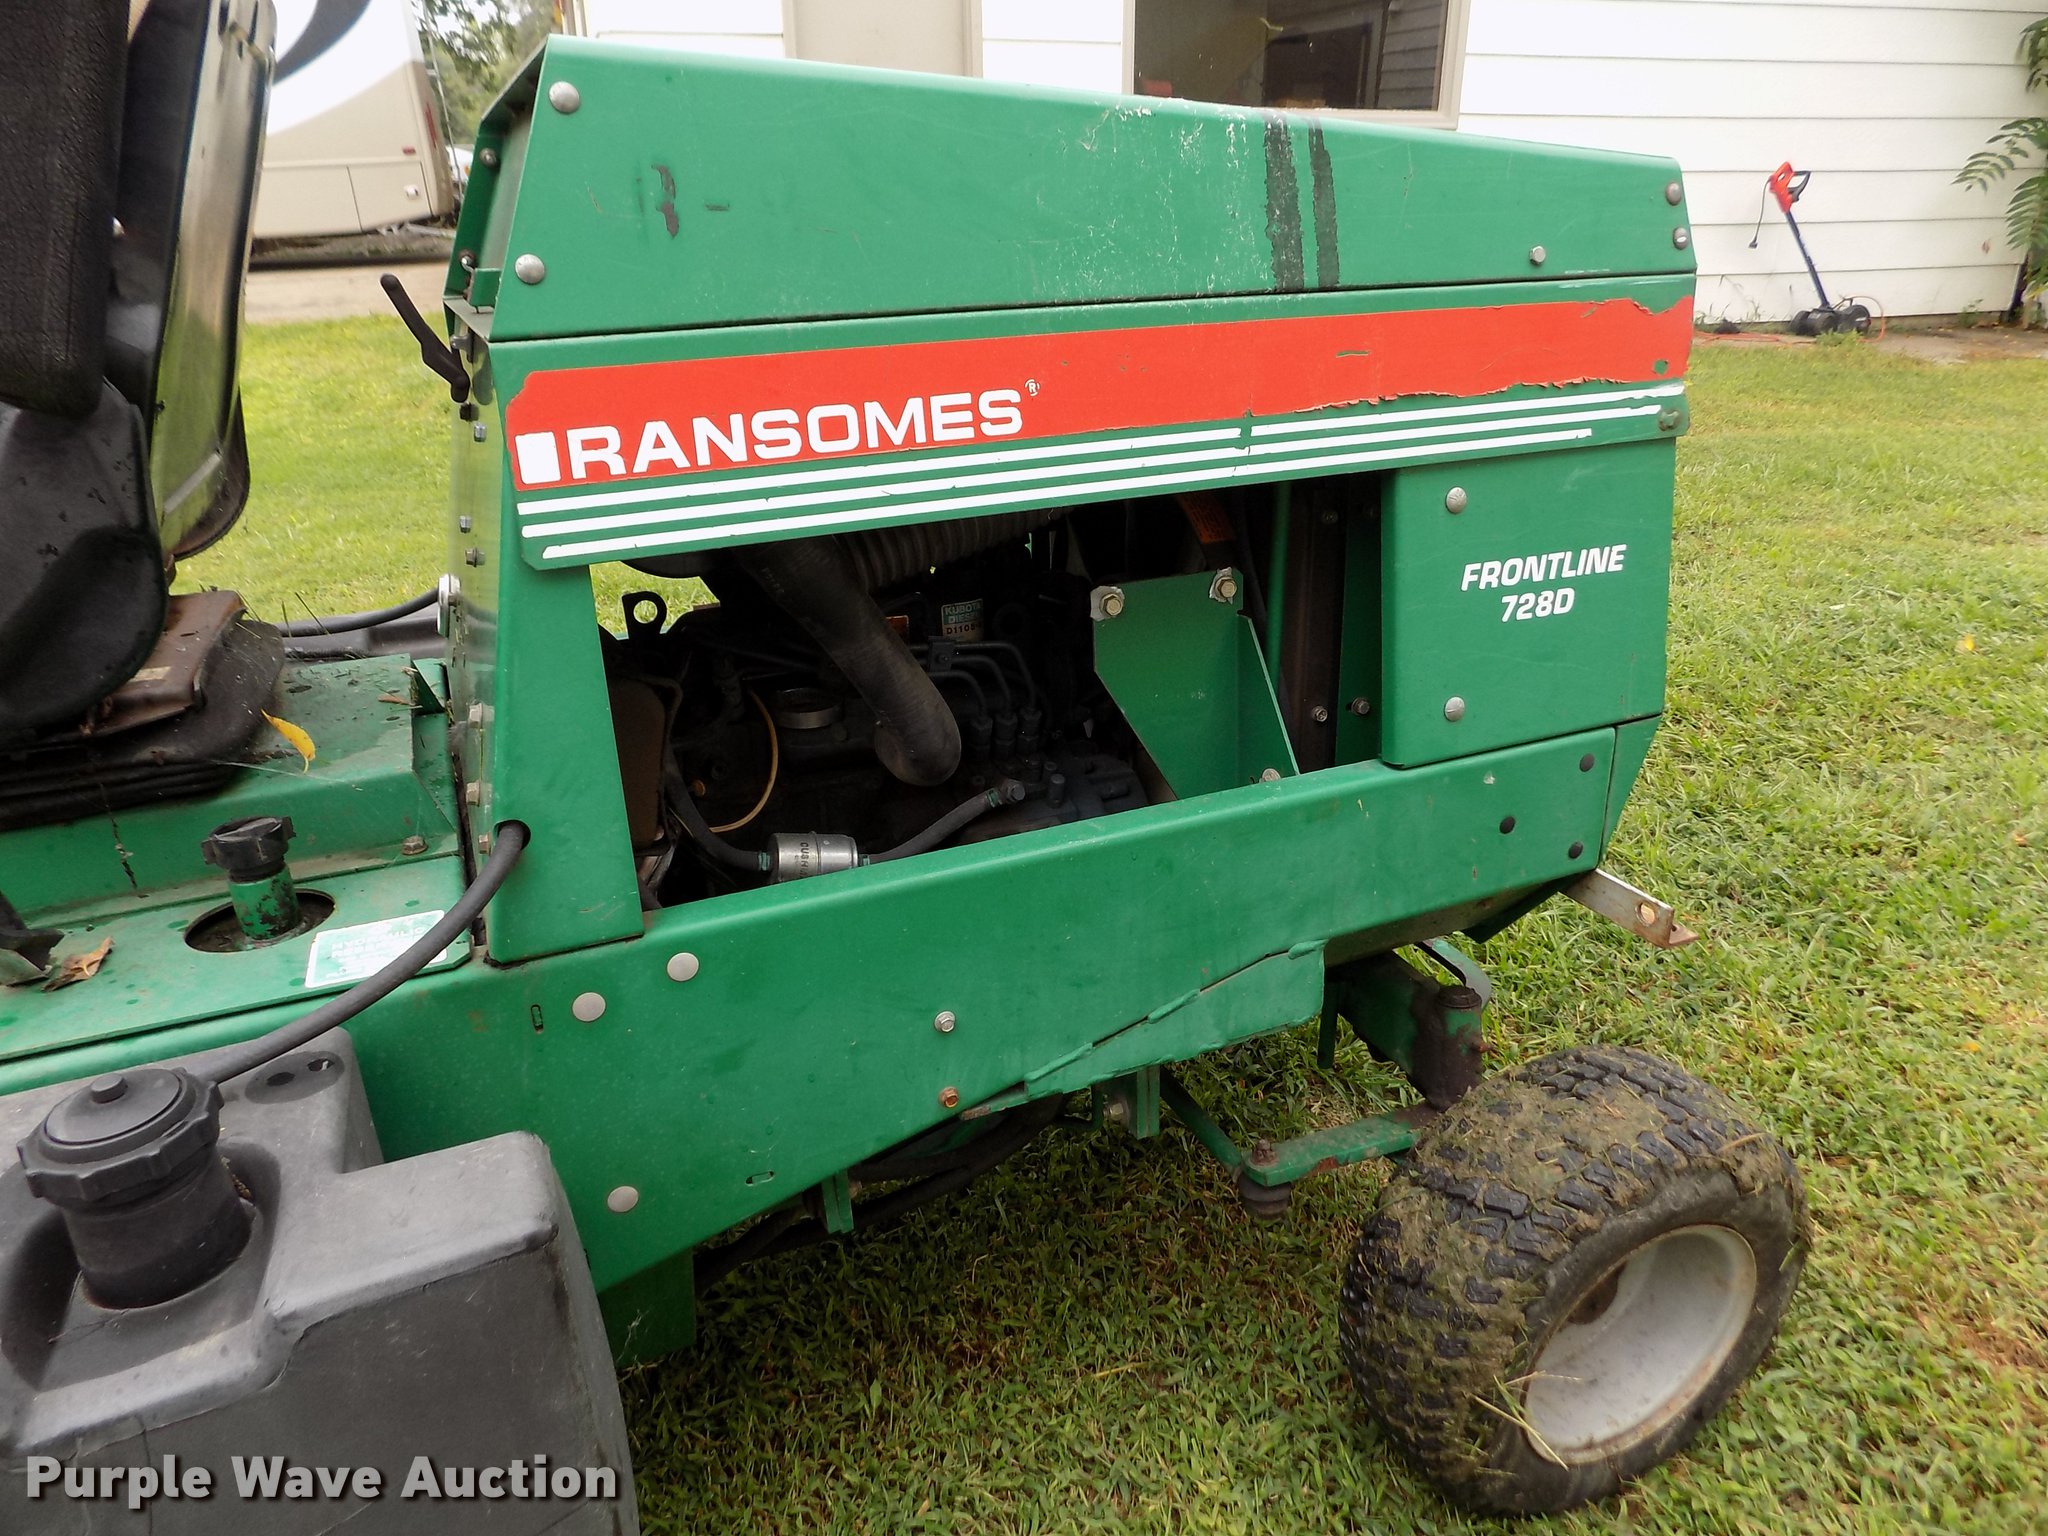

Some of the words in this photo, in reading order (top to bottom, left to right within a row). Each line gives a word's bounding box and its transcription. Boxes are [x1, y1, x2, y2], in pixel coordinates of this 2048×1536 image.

[566, 388, 1022, 480] RANSOMES
[1460, 543, 1627, 592] FRONTLINE
[1501, 587, 1575, 623] 728D
